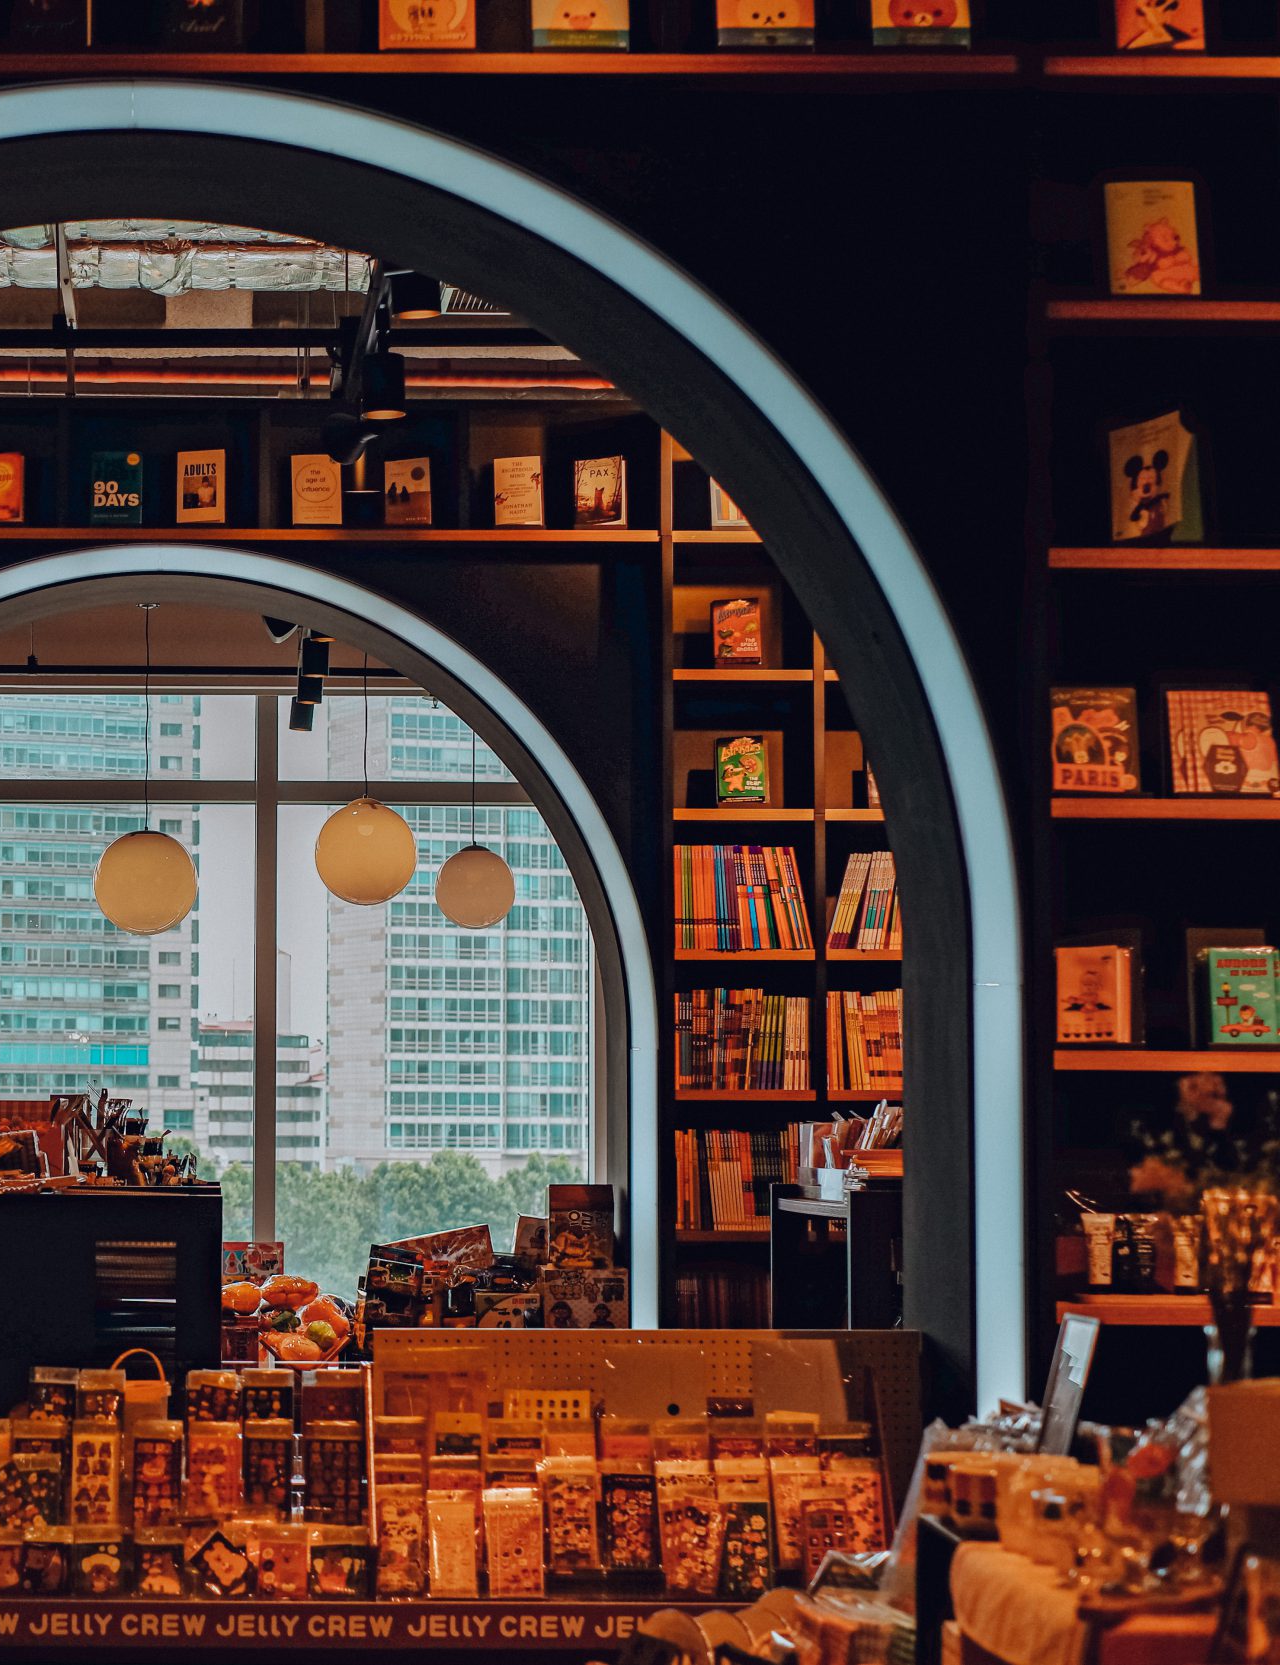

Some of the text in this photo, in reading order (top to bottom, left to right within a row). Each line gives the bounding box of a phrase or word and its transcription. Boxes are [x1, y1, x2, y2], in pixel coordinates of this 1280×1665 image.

[184, 463, 217, 476] ADULTS
[589, 468, 609, 478] PAX
[93, 480, 119, 494] 90
[93, 493, 141, 507] DAYS
[1061, 768, 1119, 788] PARIS
[29, 1613, 113, 1636] JELLY
[121, 1613, 206, 1636] CREW
[216, 1614, 300, 1637] JELLY
[308, 1615, 393, 1637] CREW
[408, 1614, 492, 1638] JELLY
[500, 1615, 585, 1638] CREW
